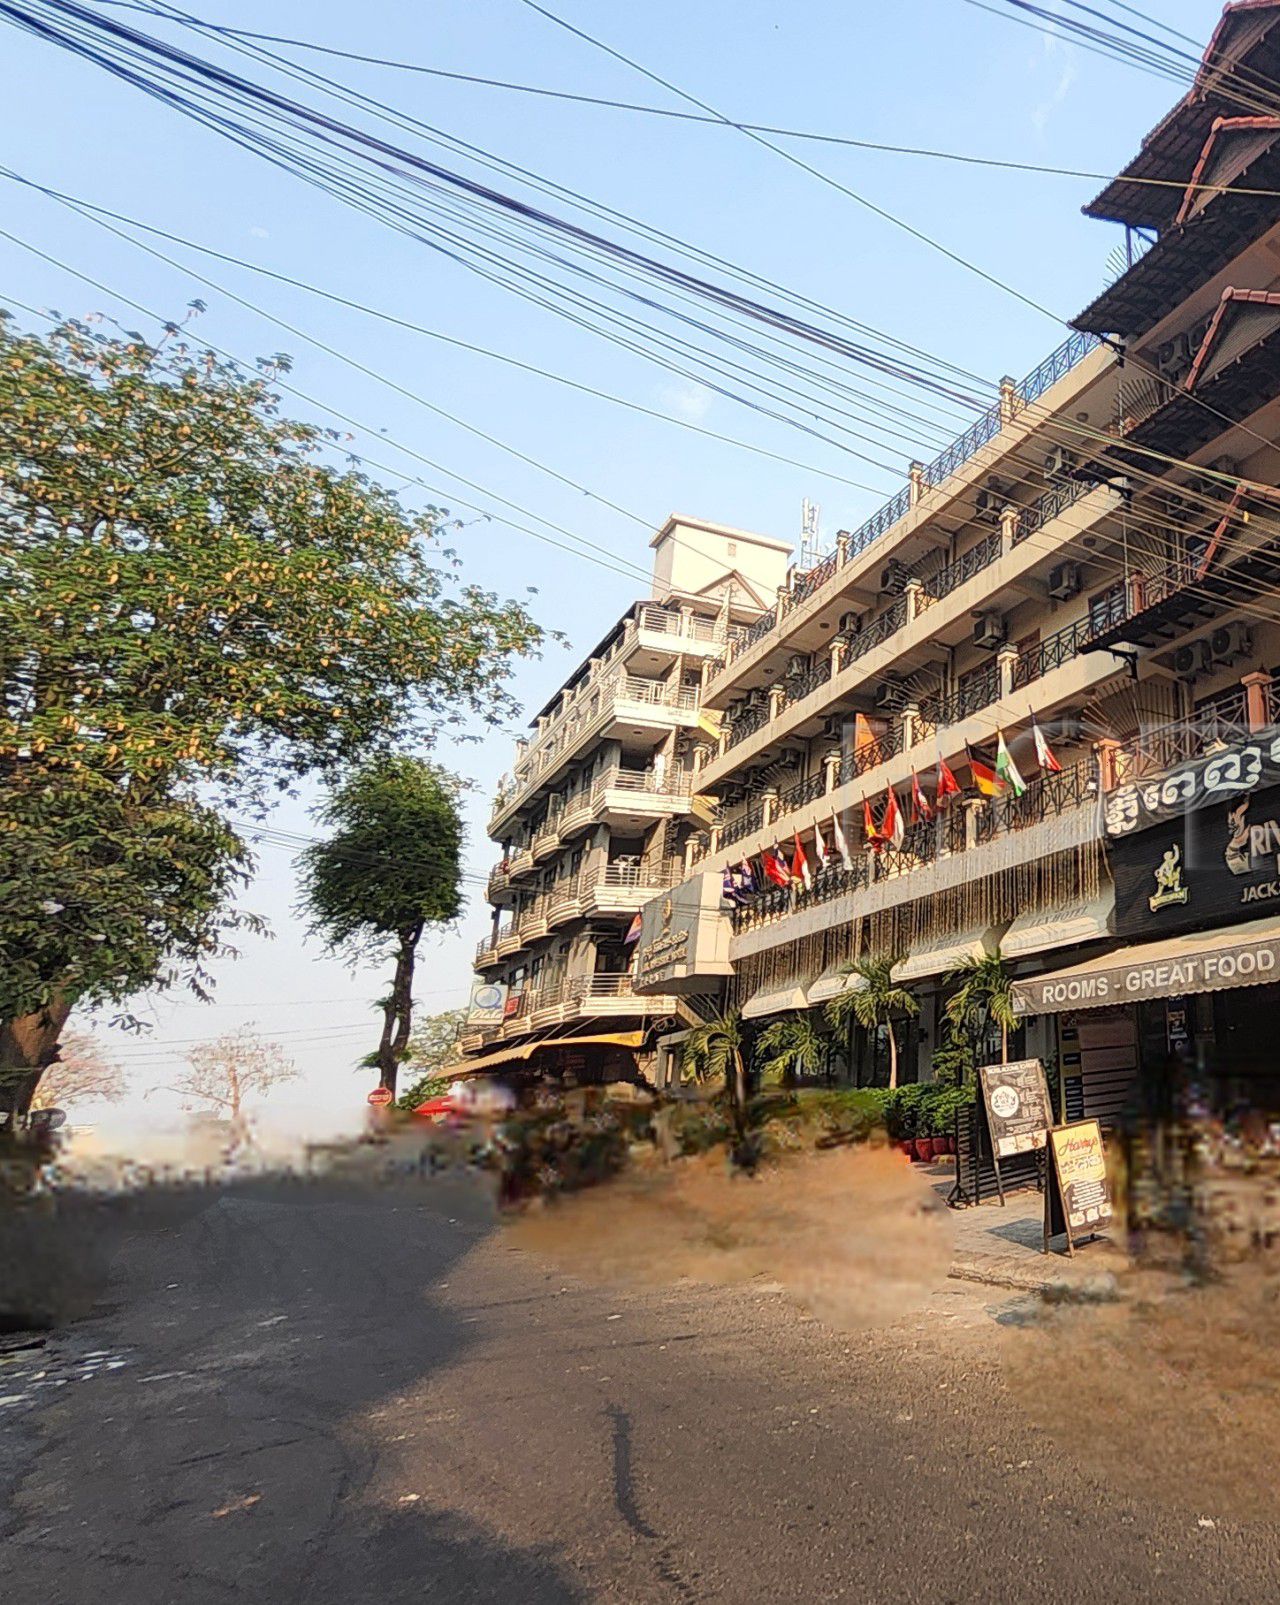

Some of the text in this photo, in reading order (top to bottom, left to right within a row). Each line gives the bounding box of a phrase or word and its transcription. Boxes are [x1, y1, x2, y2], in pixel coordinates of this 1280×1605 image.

[1041, 976, 1109, 1005] ROOMS
[1125, 961, 1199, 992] GREAT
[1204, 949, 1276, 981] FOOD
